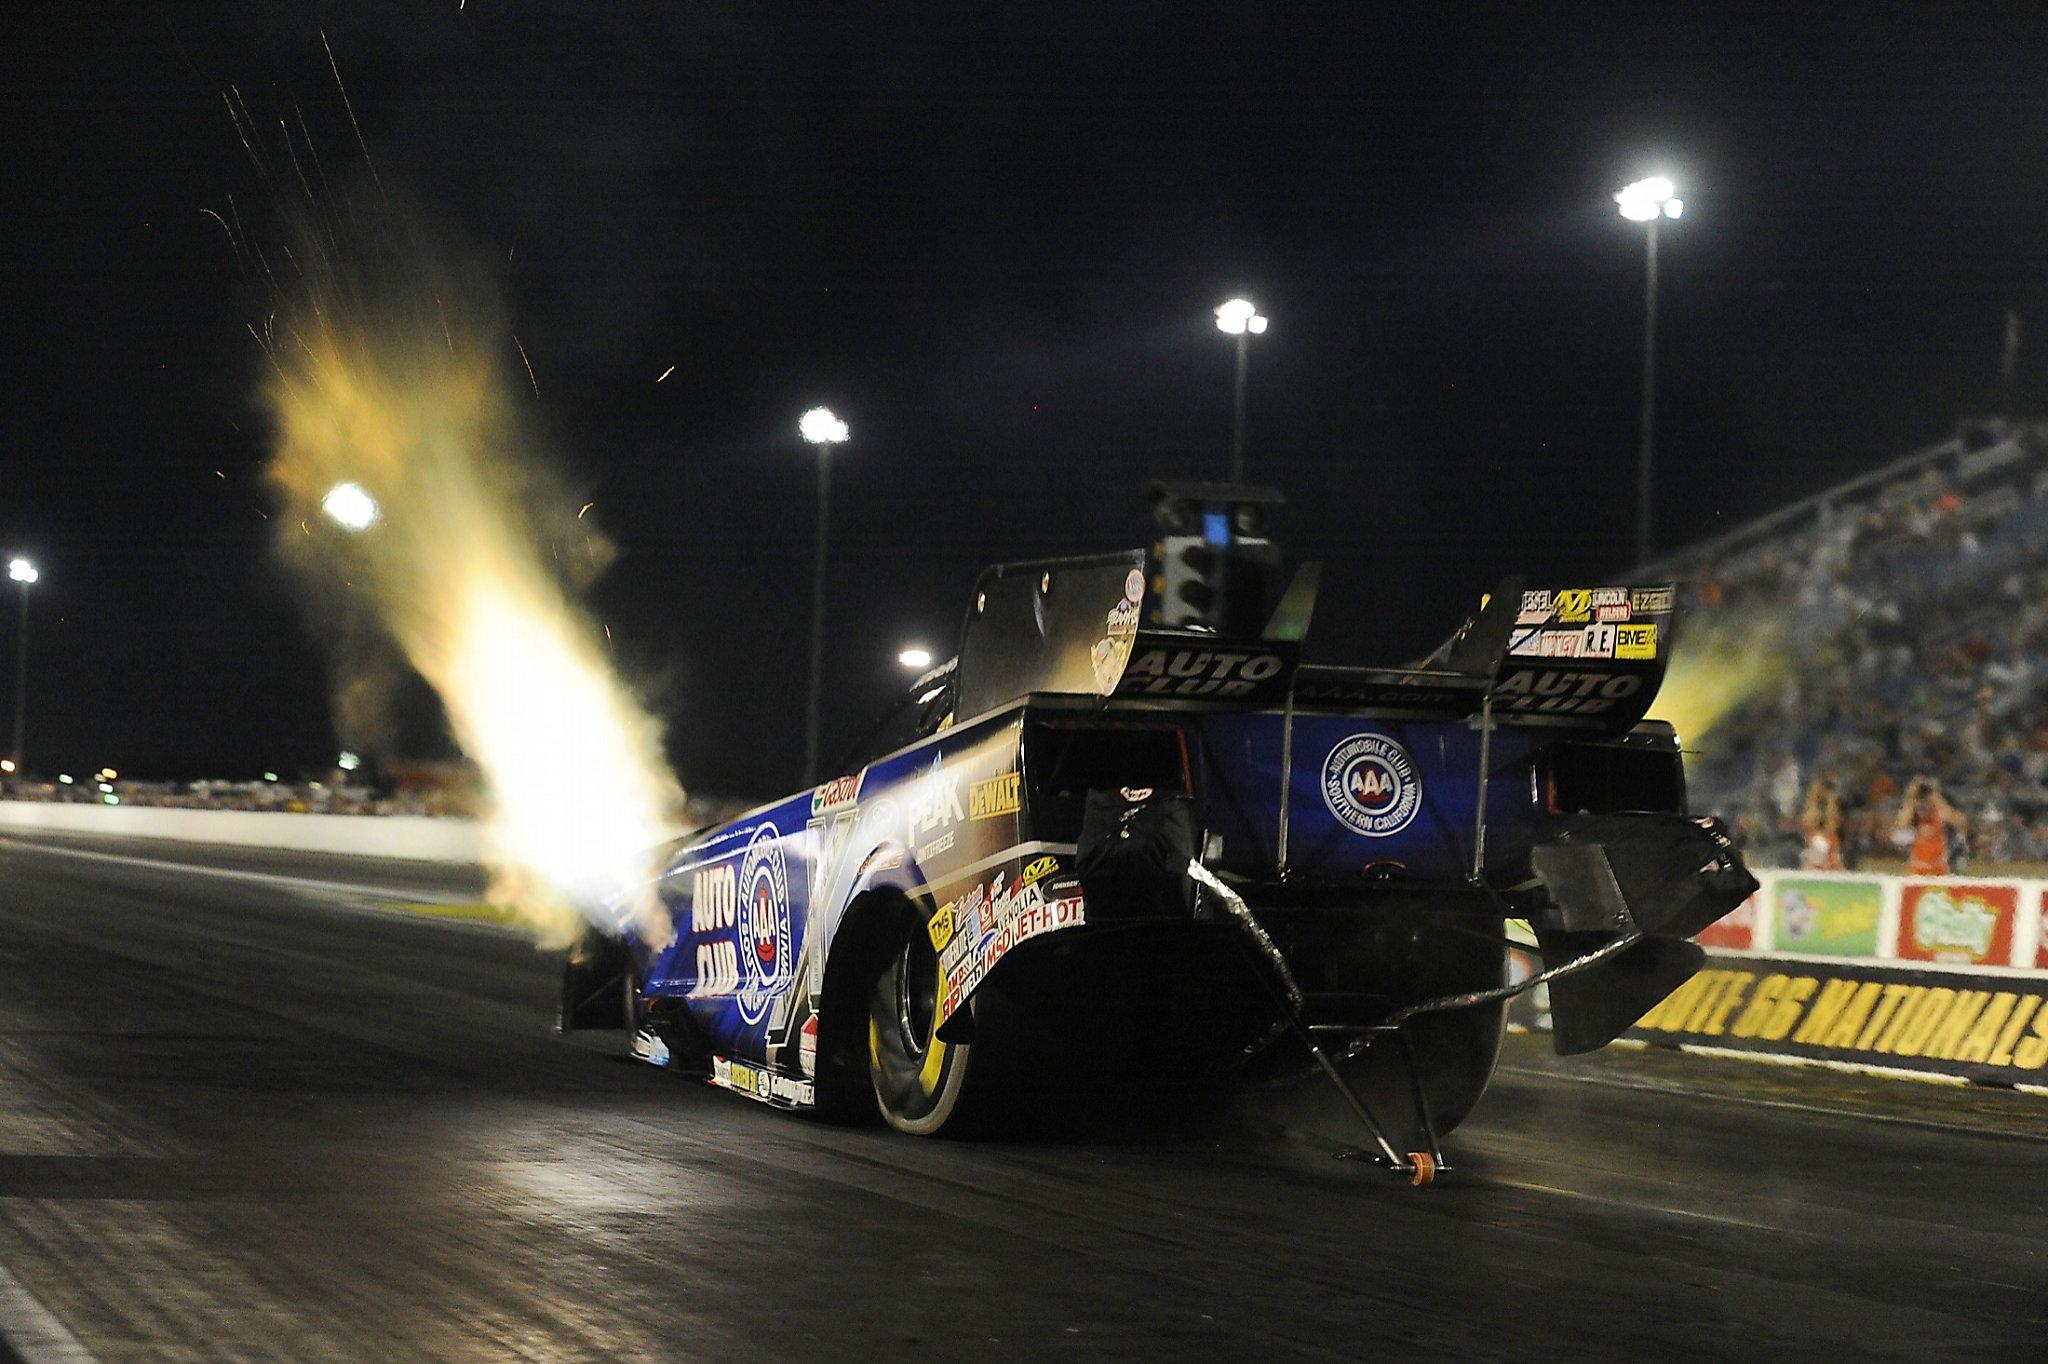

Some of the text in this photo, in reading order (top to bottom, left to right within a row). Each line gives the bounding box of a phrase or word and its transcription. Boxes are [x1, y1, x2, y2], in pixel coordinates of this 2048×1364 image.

[1130, 651, 1284, 681] AUTO
[1493, 669, 1643, 698] AUTO
[1328, 738, 1412, 779] AUTOMOBILE CLUB
[1327, 779, 1417, 831] SOUTHERN CALIFORNIA
[1350, 769, 1394, 796] AAA
[691, 864, 736, 933] AUTO
[771, 848, 786, 904] CLUB
[752, 896, 776, 946] AAA
[1014, 898, 1083, 942] JET-HOT
[985, 926, 1011, 971] MSD
[1731, 972, 1820, 1041] 66
[1792, 977, 2048, 1070] NATIONALS
